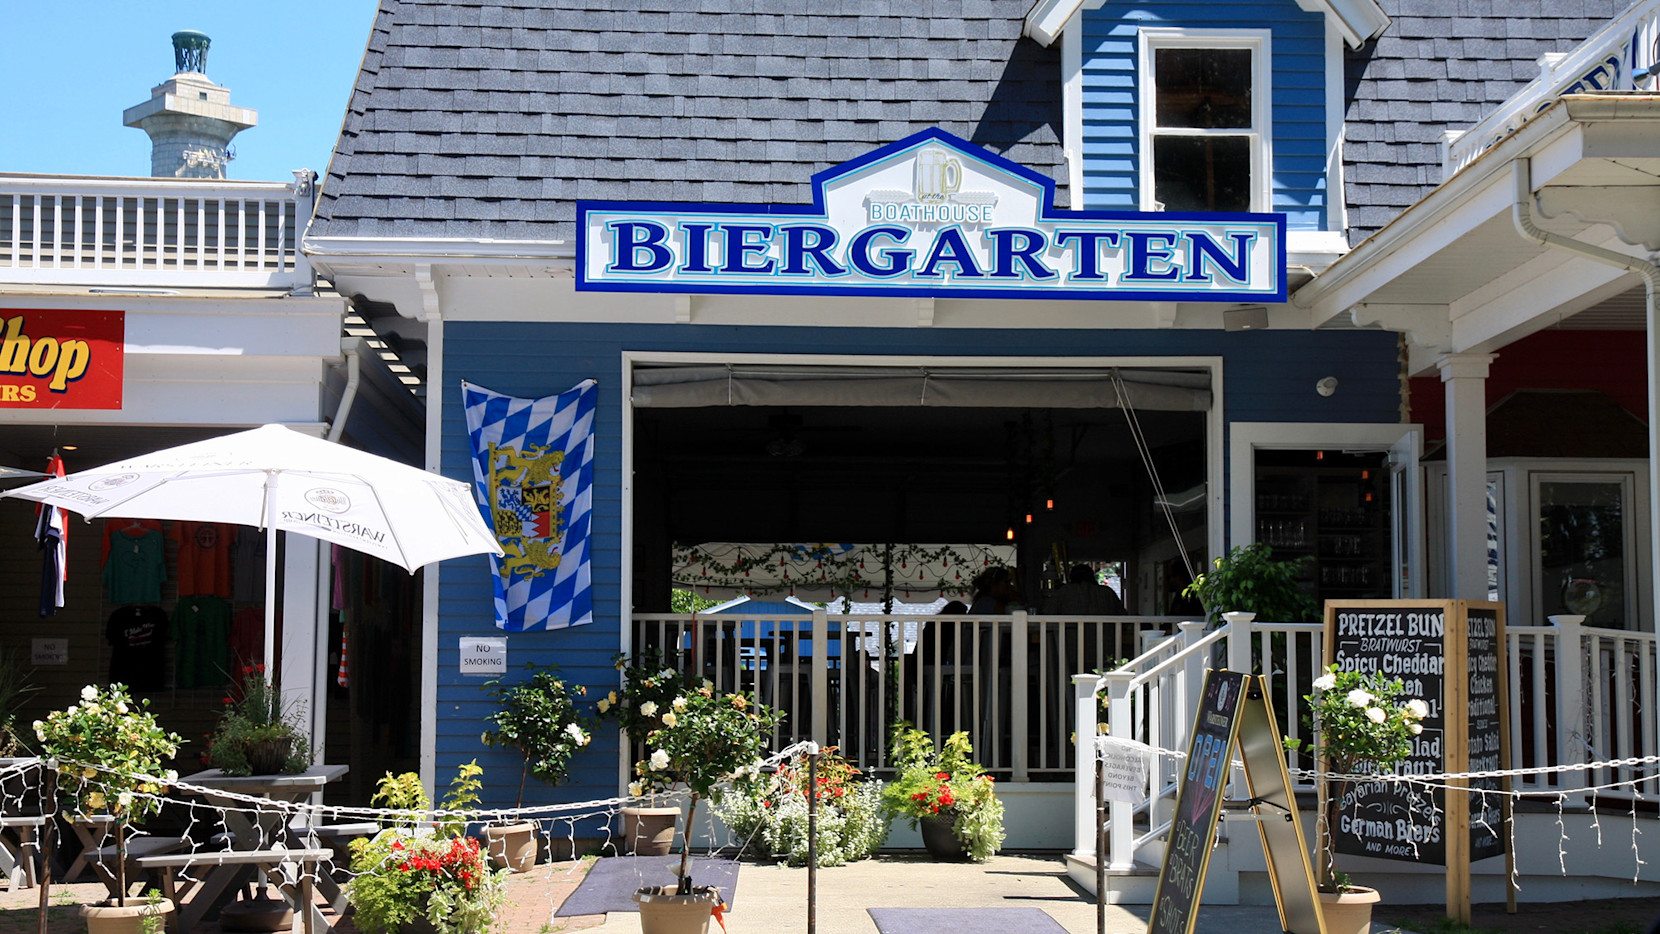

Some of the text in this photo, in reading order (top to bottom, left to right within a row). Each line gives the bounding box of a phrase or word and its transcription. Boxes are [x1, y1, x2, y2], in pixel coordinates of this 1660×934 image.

[871, 204, 993, 221] BOATHOUSE
[606, 220, 1257, 285] BIERGARTEN
[0, 315, 91, 393] hop
[0, 384, 36, 402] RS
[1338, 613, 1444, 637] PRETZEL BUN
[476, 644, 491, 652] NO
[1360, 638, 1422, 652] BRATWURST
[1337, 650, 1444, 676] Spicy Cheddar
[1400, 736, 1441, 758] alad
[1188, 734, 1227, 791] OPEN
[1341, 815, 1440, 843] German Biers
[1176, 820, 1199, 867] BEER
[1366, 842, 1382, 852] AND
[1169, 853, 1194, 900] BRATS
